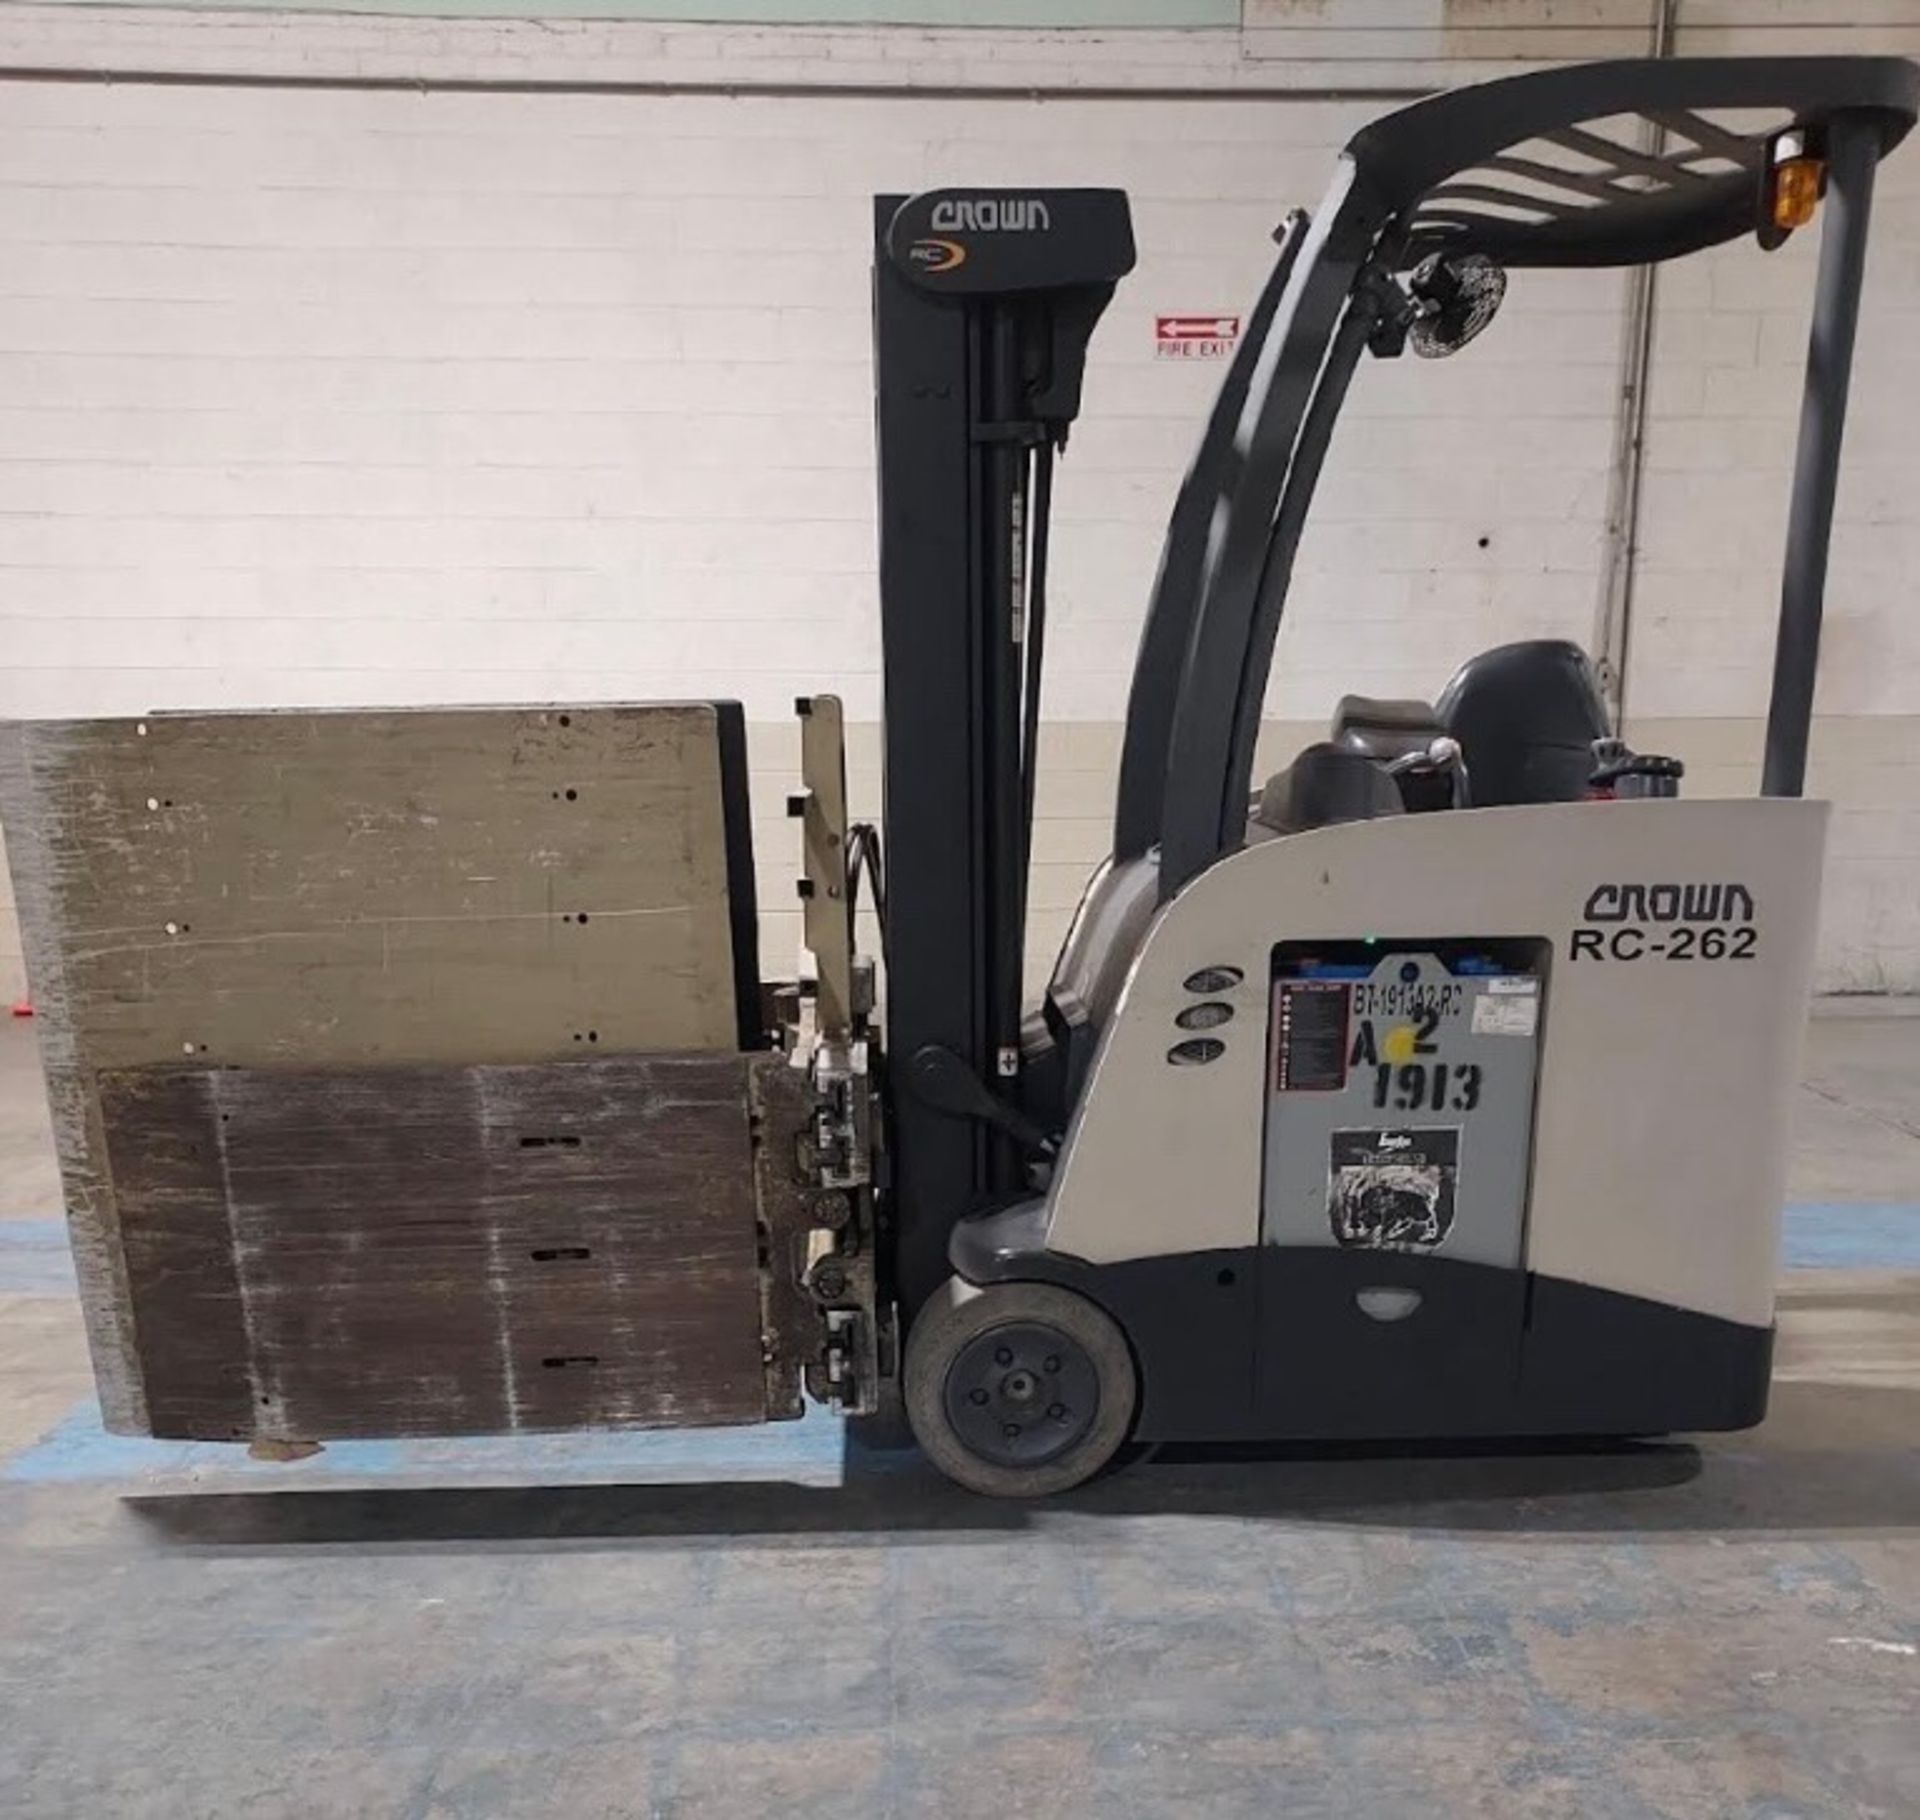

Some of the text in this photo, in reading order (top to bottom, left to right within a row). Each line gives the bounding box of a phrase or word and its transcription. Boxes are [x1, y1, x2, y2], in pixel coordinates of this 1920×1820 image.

[931, 199, 1050, 231] CROWN
[1158, 341, 1192, 356] FIRE
[1583, 883, 1754, 922] CROWN
[1569, 927, 1757, 961] RC-262
[1349, 1020, 1378, 1066] A
[1413, 1007, 1439, 1054] 2
[1374, 1062, 1482, 1111] 1913
